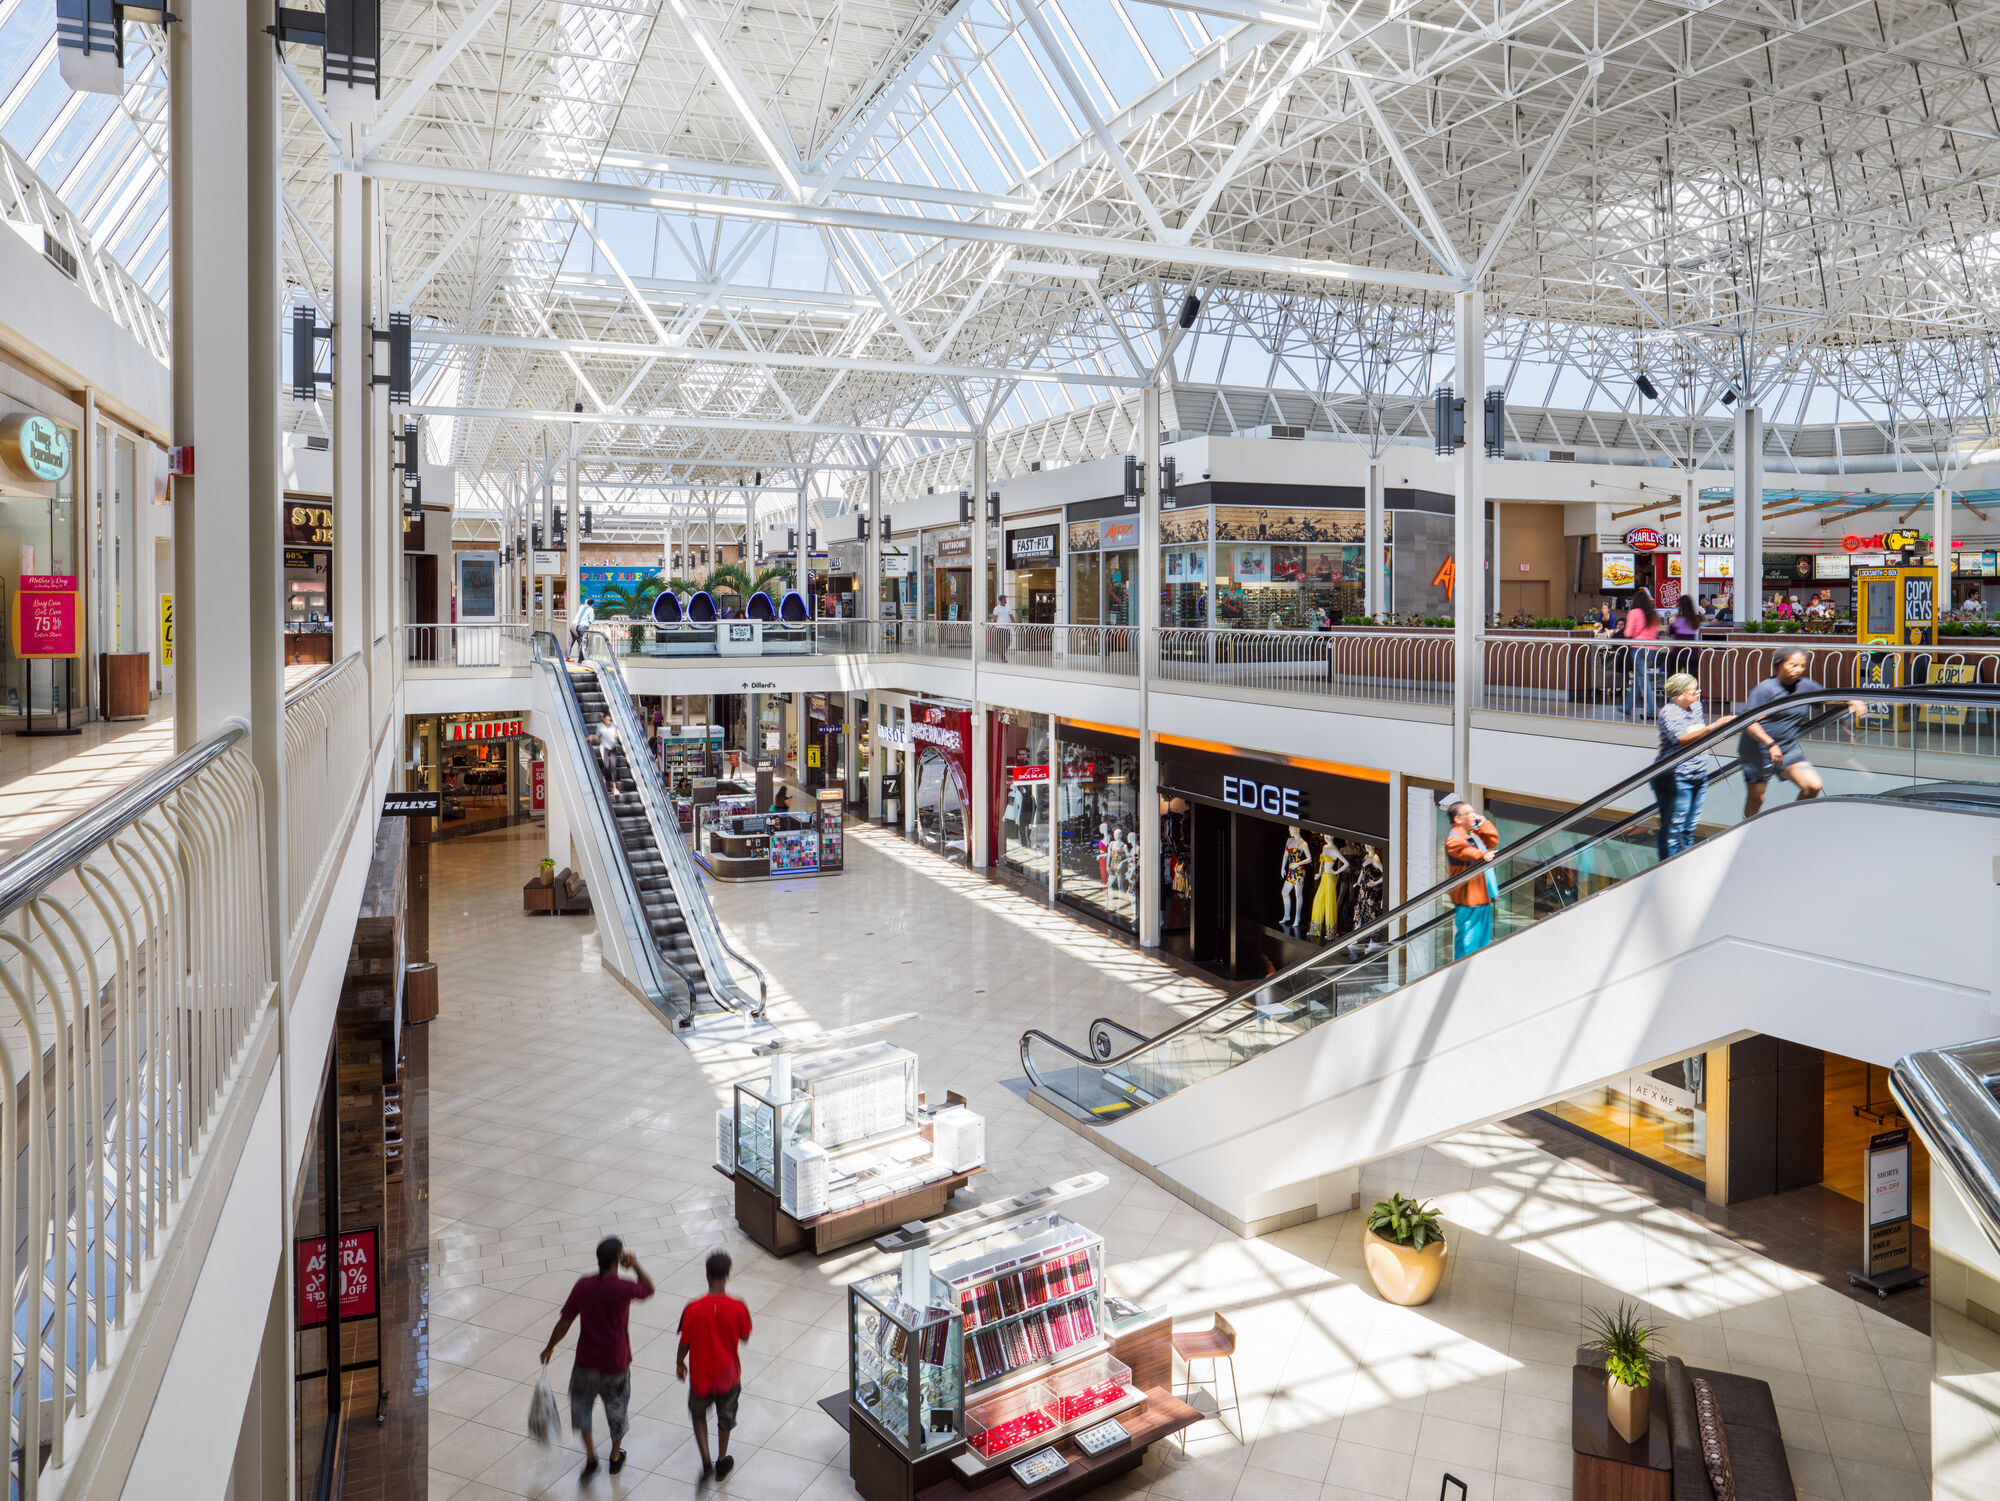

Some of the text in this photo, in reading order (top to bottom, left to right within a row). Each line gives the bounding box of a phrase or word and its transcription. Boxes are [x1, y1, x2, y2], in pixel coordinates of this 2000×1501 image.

[1626, 532, 1665, 545] CHARLEYS
[581, 572, 650, 581] PLAY AREA
[1906, 580, 1932, 600] COPY
[33, 599, 61, 608] Buy One
[35, 608, 47, 616] Get
[1905, 600, 1932, 620] KEYS
[1223, 775, 1300, 820] EDGE
[384, 800, 438, 810] TILLYS
[1636, 1085, 1649, 1096] AE
[1660, 1095, 1675, 1107] ME
[1877, 1168, 1899, 1179] SHORTS
[1889, 1182, 1900, 1191] OFF
[345, 1239, 358, 1249] AN
[348, 1284, 368, 1295] OFF
